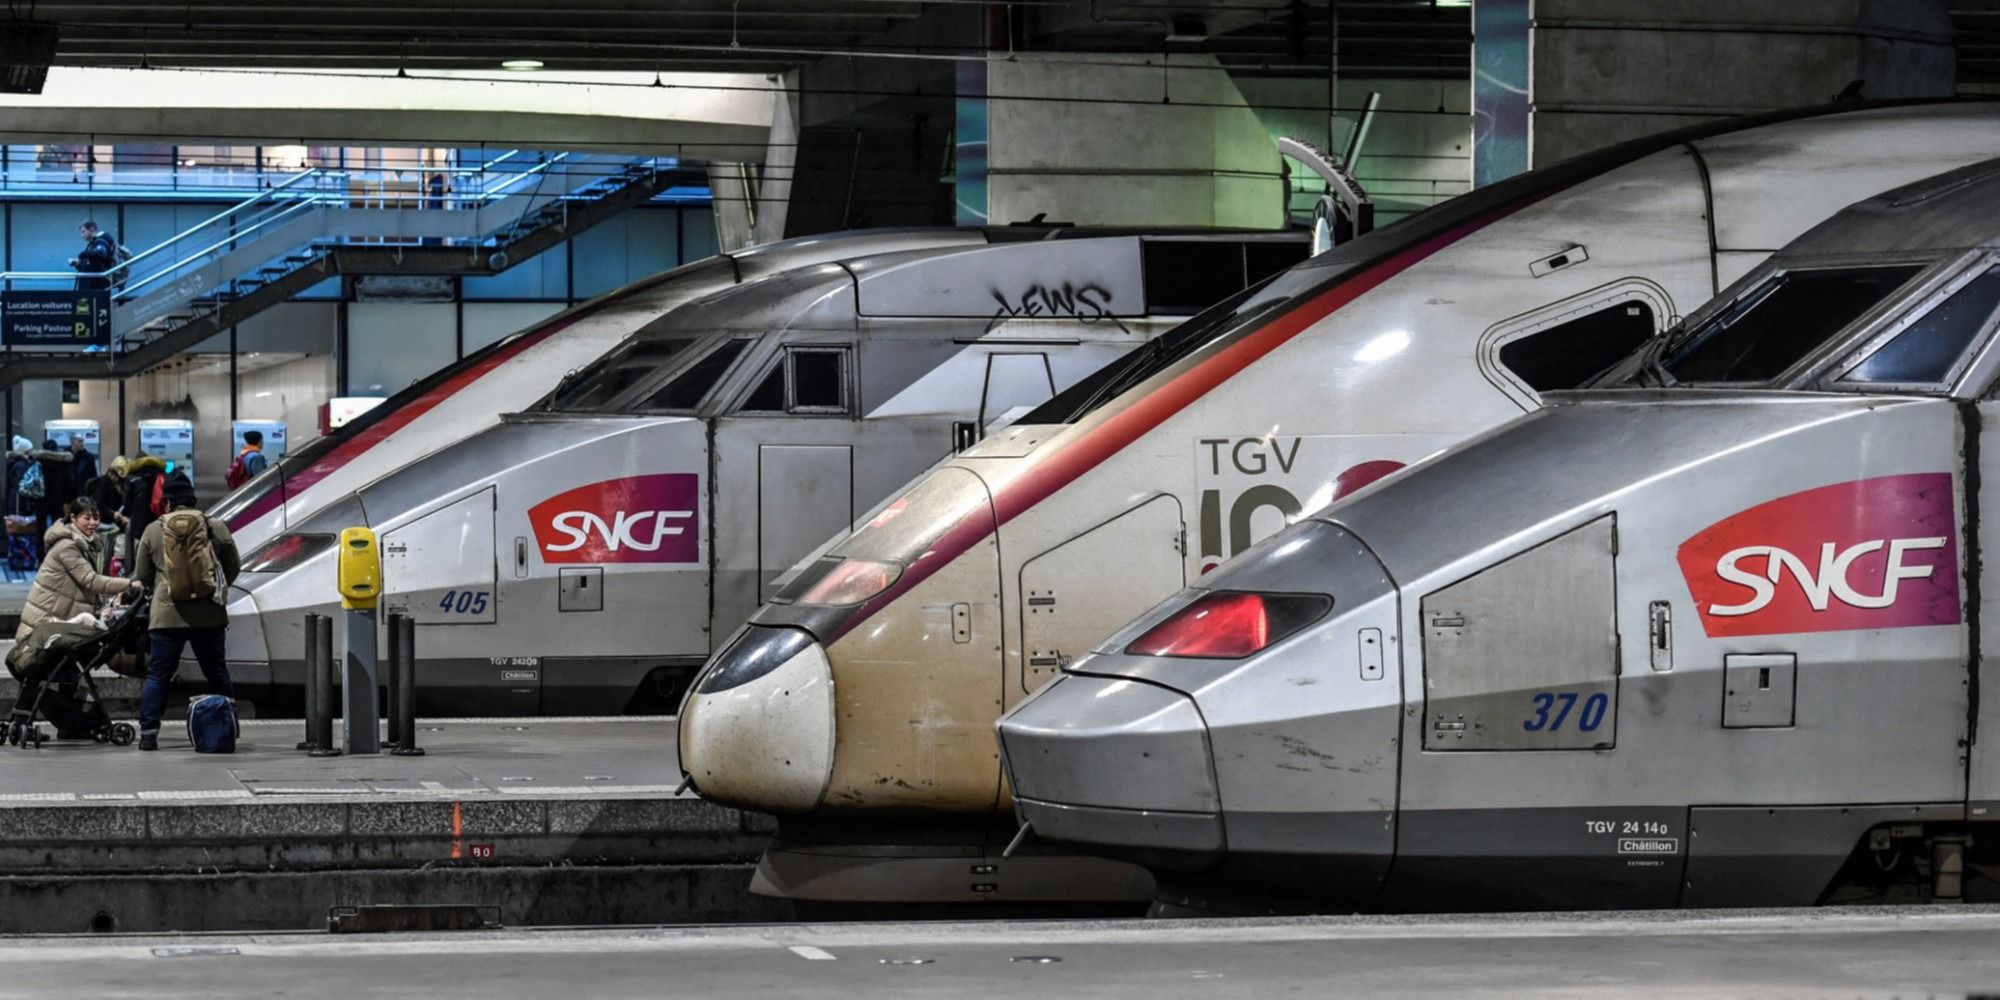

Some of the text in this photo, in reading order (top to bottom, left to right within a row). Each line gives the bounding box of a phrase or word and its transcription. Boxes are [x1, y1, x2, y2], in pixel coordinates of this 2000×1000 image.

[7, 301, 73, 310] Location voitures
[14, 323, 42, 333] Parking
[43, 323, 73, 332] Pasteur
[1200, 436, 1303, 476] TGV
[546, 510, 694, 552] SNCF
[1707, 536, 1948, 616] SNCF
[439, 590, 490, 615] 405
[490, 656, 508, 665] TGV
[1523, 691, 1609, 733] 370
[1585, 820, 1617, 834] TGV
